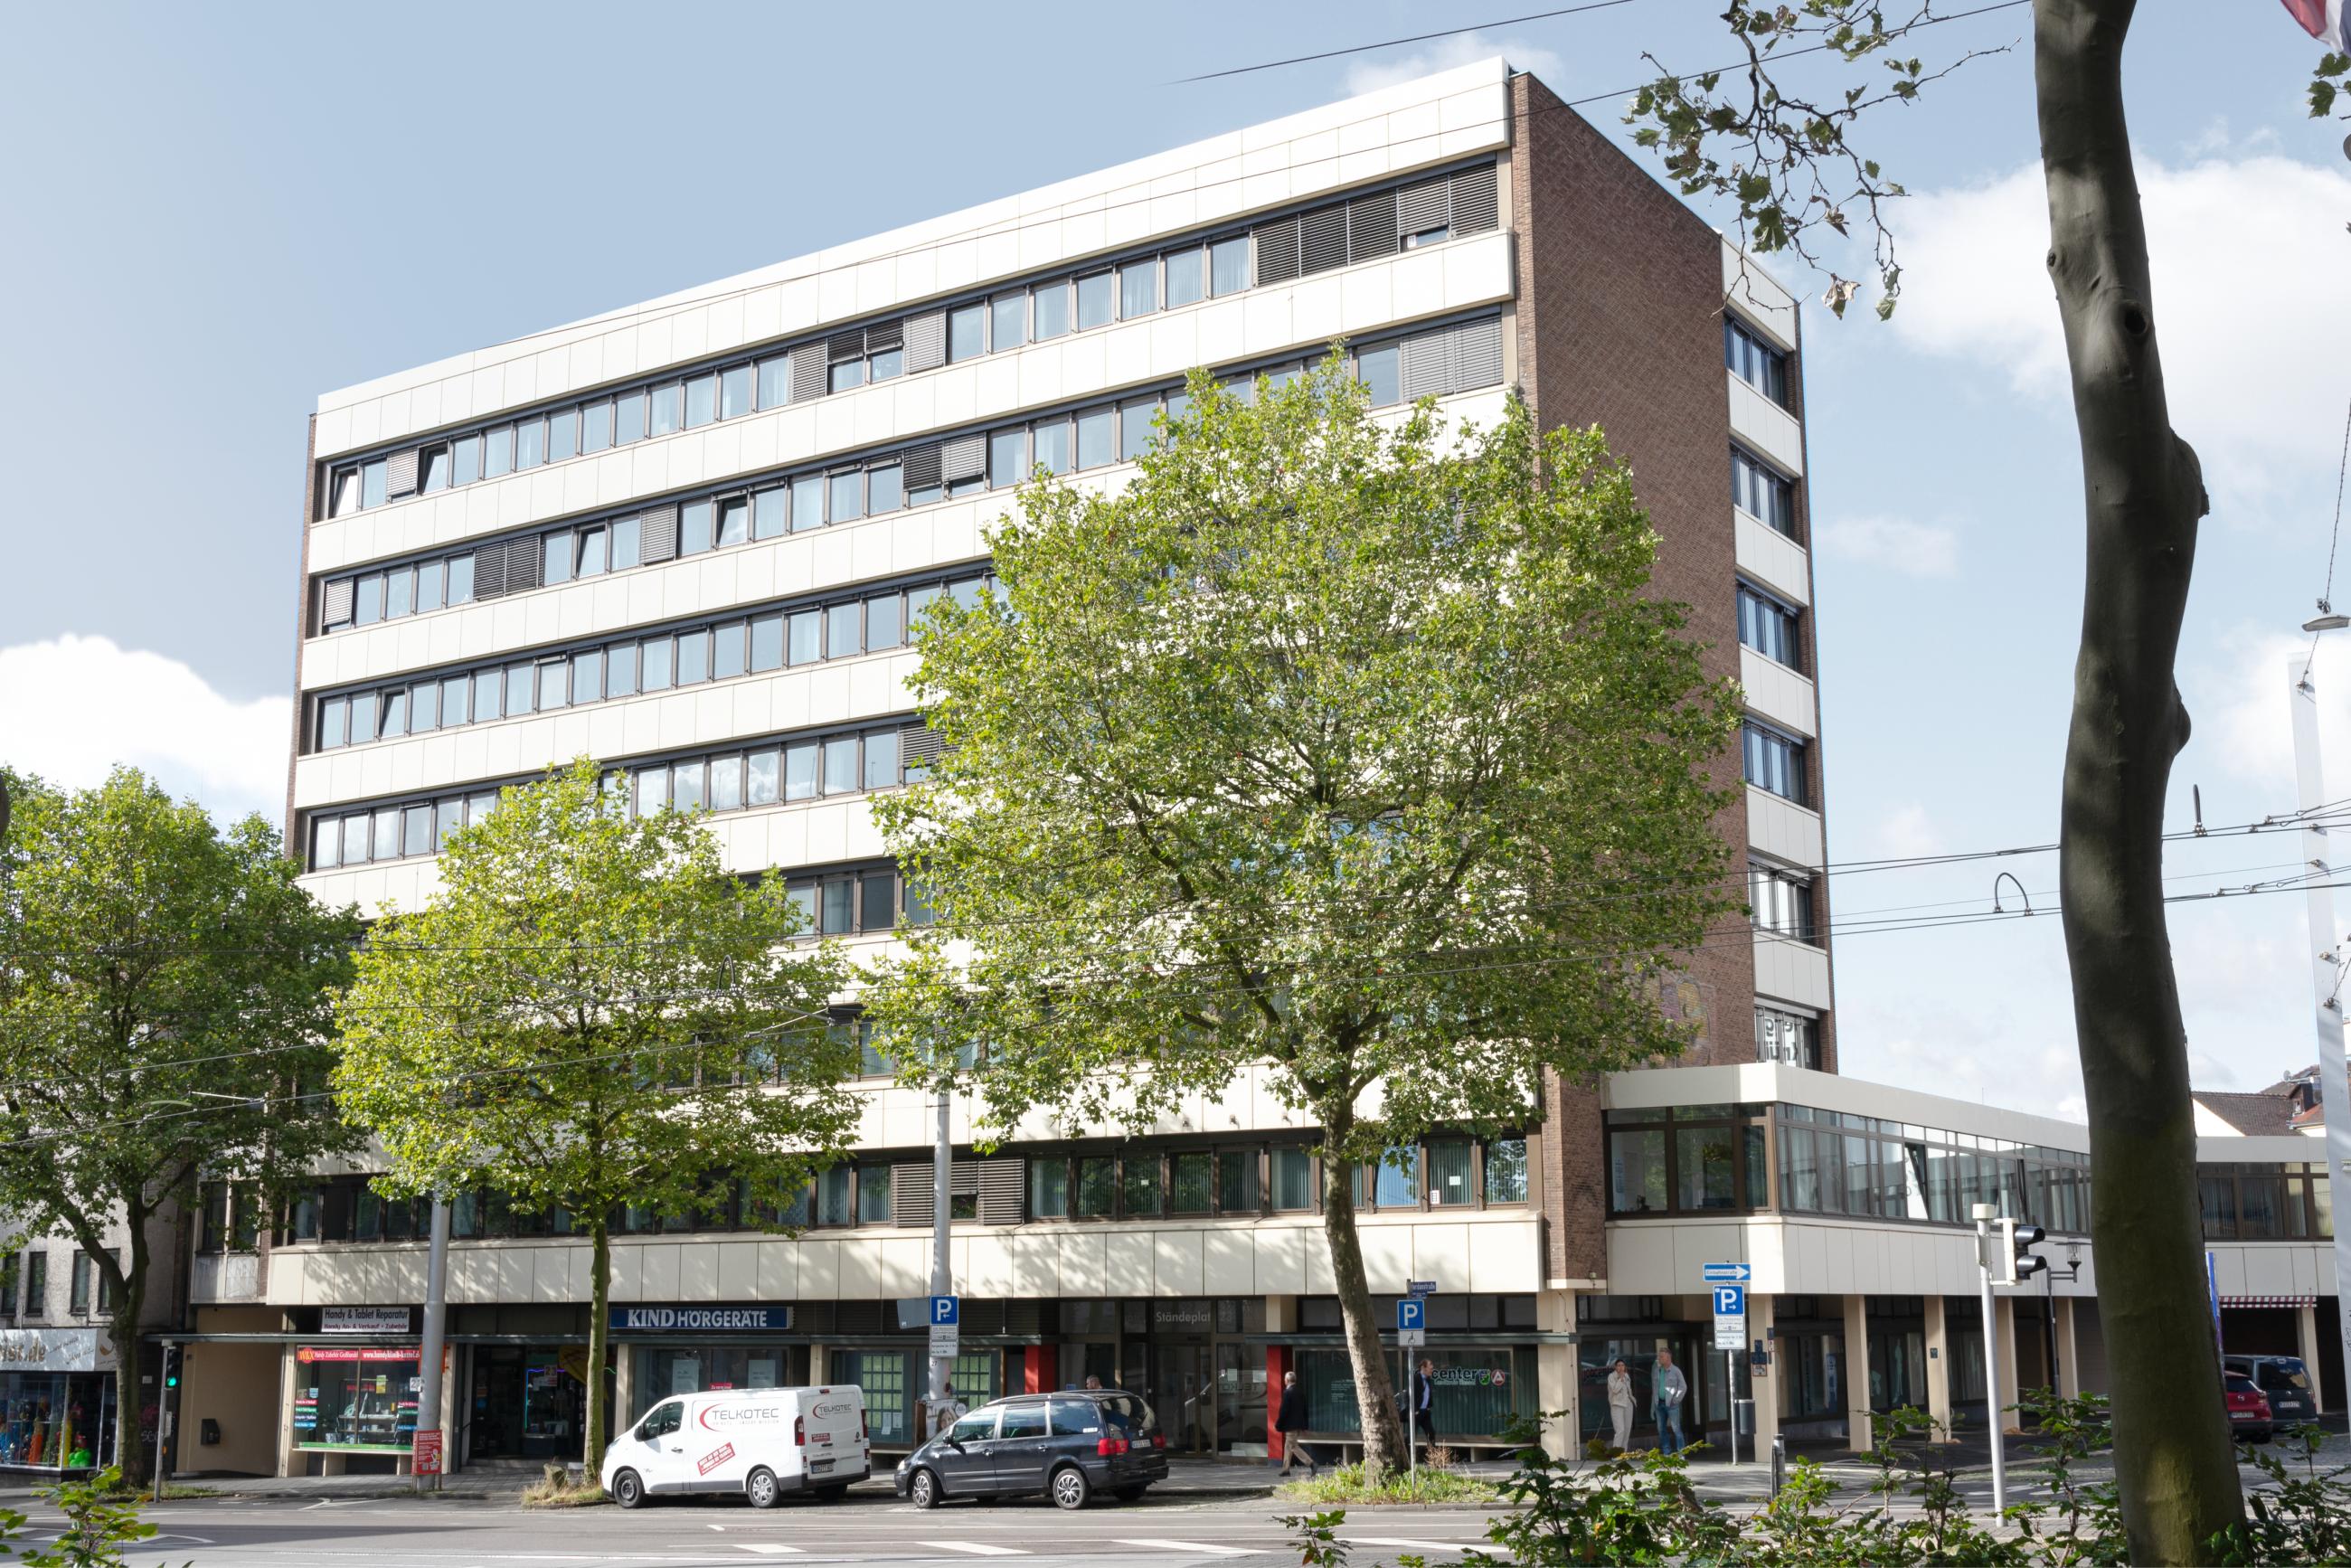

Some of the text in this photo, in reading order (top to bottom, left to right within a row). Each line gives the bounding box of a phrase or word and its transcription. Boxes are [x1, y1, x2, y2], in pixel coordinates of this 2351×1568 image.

[1721, 1289, 1736, 1312] P
[326, 1308, 409, 1321] Handy & Tablet Reparatur
[628, 1308, 768, 1327] KIND HÖRGERÄTE
[937, 1299, 952, 1322] P
[1404, 1304, 1418, 1327] P
[1156, 1311, 1211, 1325] Ständeplat
[299, 1350, 315, 1360] W&X
[1413, 1366, 1478, 1381] center
[712, 1408, 779, 1421] TELKOTEC
[818, 1403, 852, 1413] TELKOTEC
